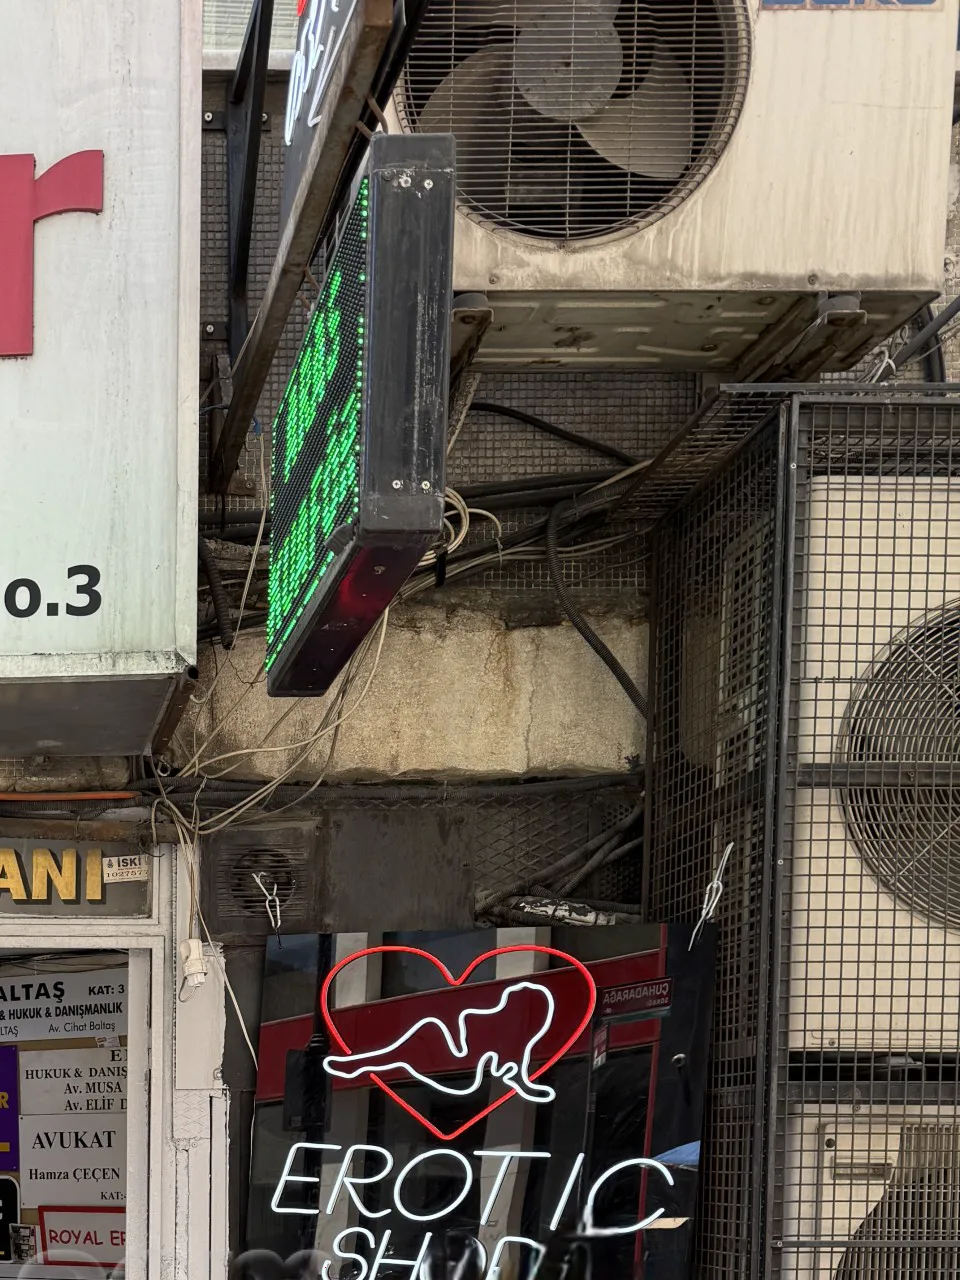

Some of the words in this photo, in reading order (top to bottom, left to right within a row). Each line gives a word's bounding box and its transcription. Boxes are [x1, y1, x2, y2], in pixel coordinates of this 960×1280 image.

[88, 984, 115, 996] KAT:
[118, 984, 125, 994] 3
[0, 1009, 6, 1021] &
[8, 1007, 43, 1021] HUKUK
[45, 1006, 52, 1018] &
[54, 1001, 123, 1020] DANIŞMANLIK
[48, 1023, 61, 1034] Av.
[63, 1020, 87, 1033] Cihat
[89, 1019, 116, 1032] Baltaş
[110, 1048, 127, 1062] E
[25, 1068, 72, 1080] HUKUK
[74, 1067, 83, 1078] &
[64, 1083, 82, 1095] Av.
[85, 1081, 123, 1094] MUSA
[64, 1099, 83, 1111] Av.
[86, 1095, 115, 1111] ELİF
[32, 1130, 117, 1149] AVUKAT
[29, 1168, 70, 1180] Hamza
[72, 1167, 121, 1183] ÇEÇEN
[270, 1141, 675, 1237] EROTIC
[48, 1228, 104, 1246] ROYAL
